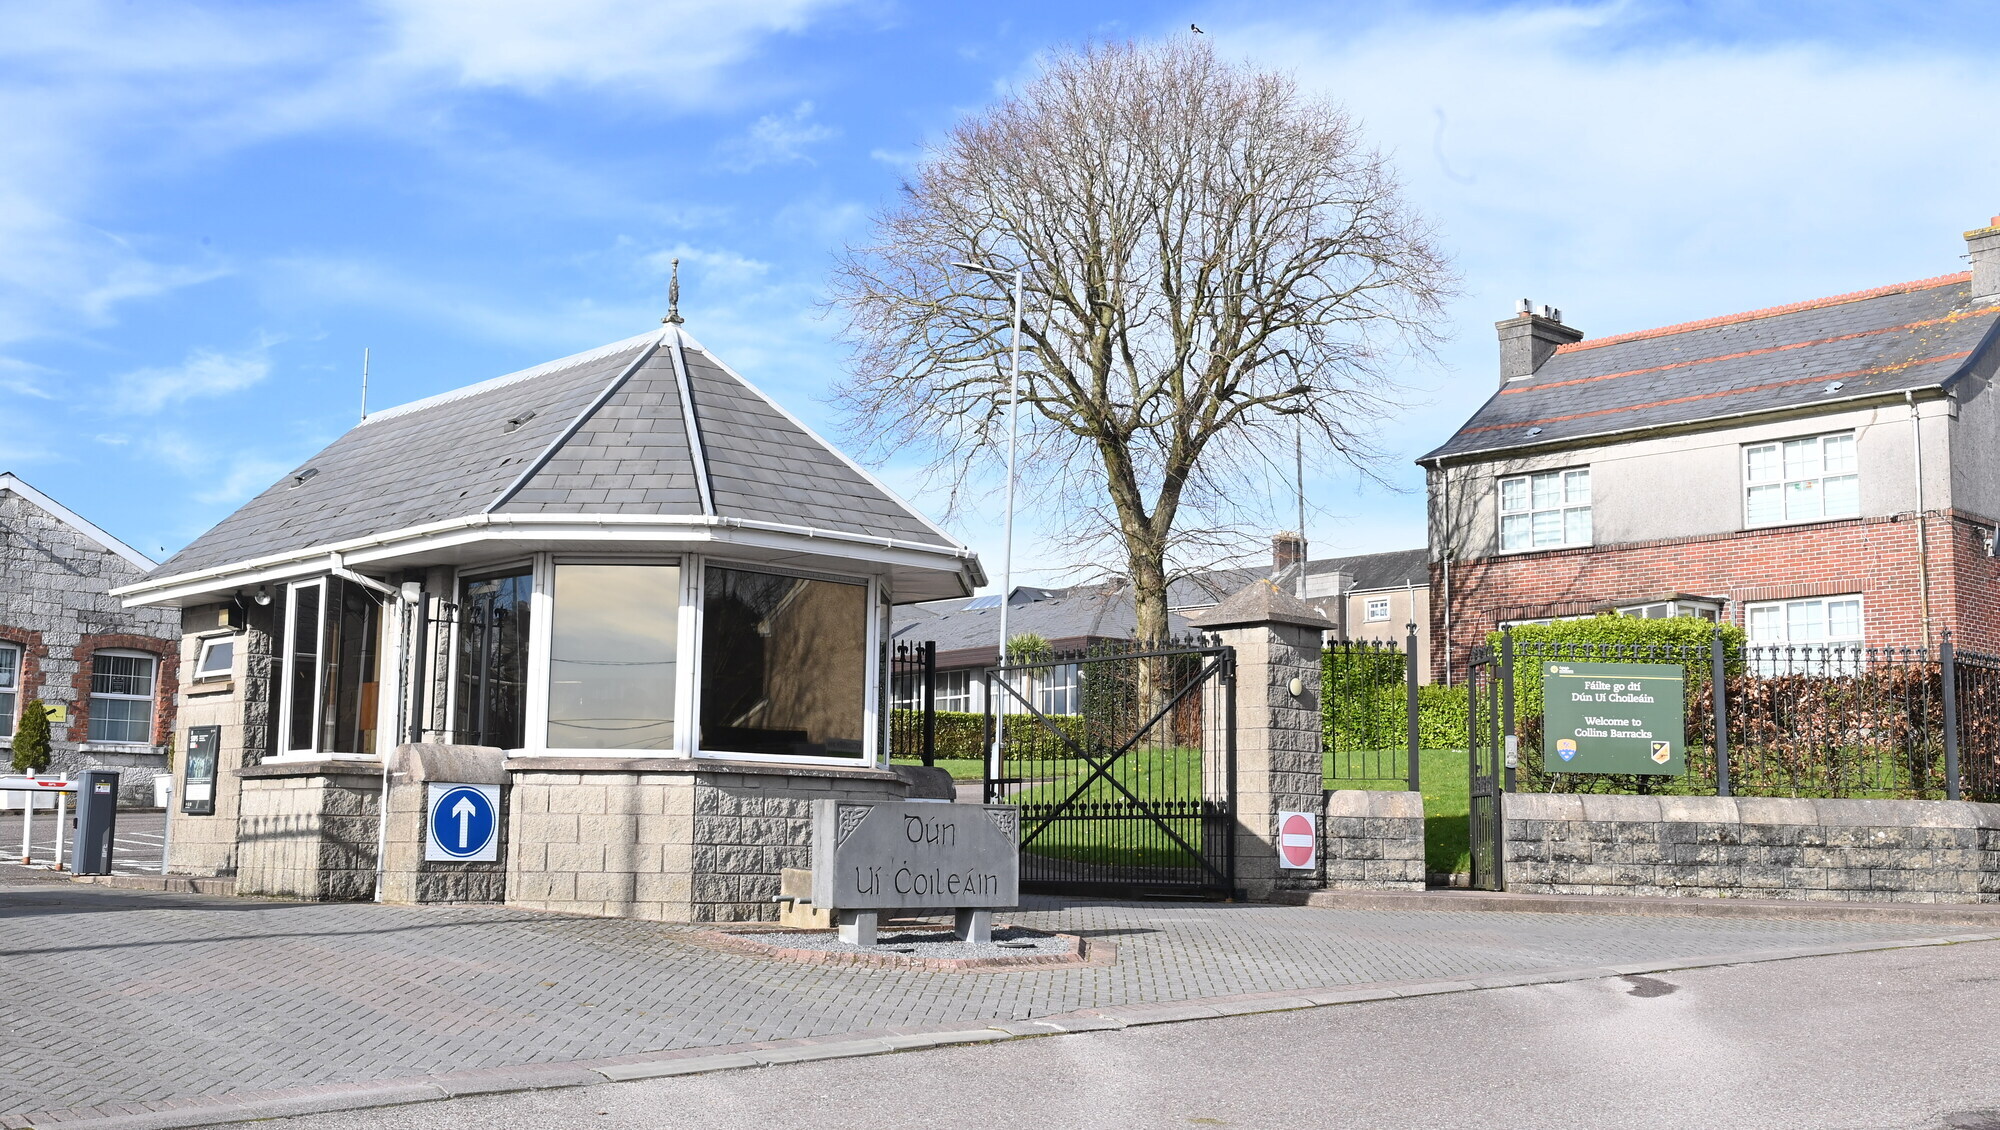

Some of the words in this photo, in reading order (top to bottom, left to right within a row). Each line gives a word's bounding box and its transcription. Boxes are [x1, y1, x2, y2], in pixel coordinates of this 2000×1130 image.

[1584, 681, 1611, 690] Fáilte
[1613, 683, 1625, 693] go
[1627, 682, 1641, 691] dtí
[1571, 692, 1593, 702] Dún
[1595, 693, 1607, 702] Uí
[1608, 693, 1655, 703] Choileáin
[1584, 716, 1629, 726] Welcome
[1631, 718, 1642, 727] to
[1574, 728, 1608, 738] Collins
[1610, 729, 1653, 739] Barracks
[904, 813, 956, 846] Dún
